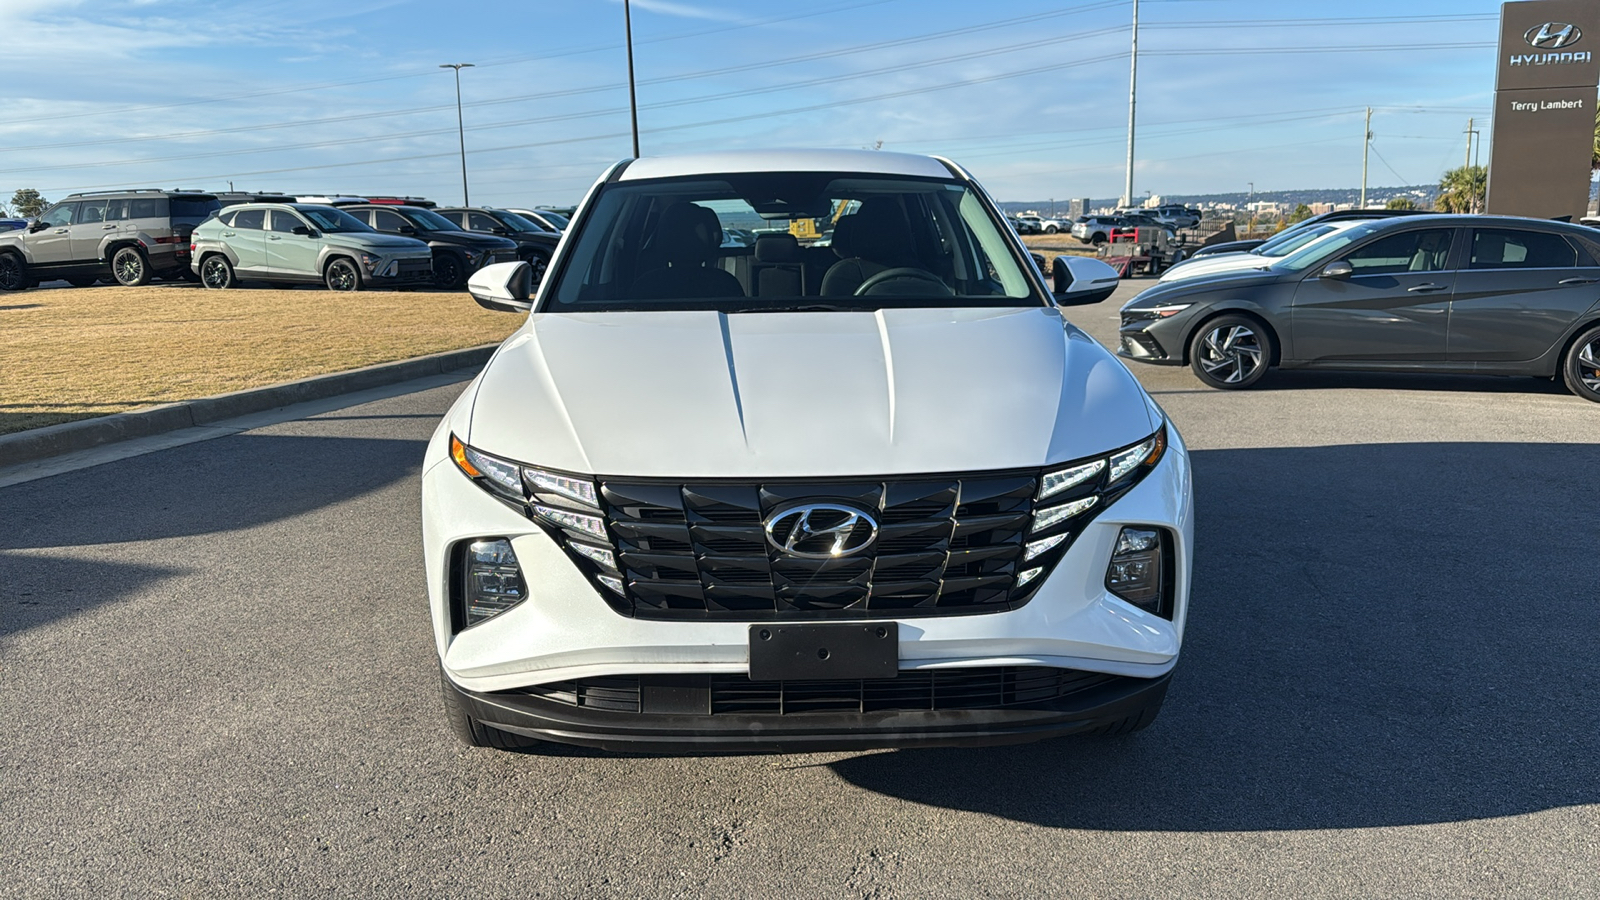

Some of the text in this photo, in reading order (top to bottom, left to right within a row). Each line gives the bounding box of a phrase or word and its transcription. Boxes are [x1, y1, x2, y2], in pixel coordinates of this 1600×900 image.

[1510, 51, 1592, 66] HYUNDAI
[1511, 99, 1583, 112] Terry Lambert
